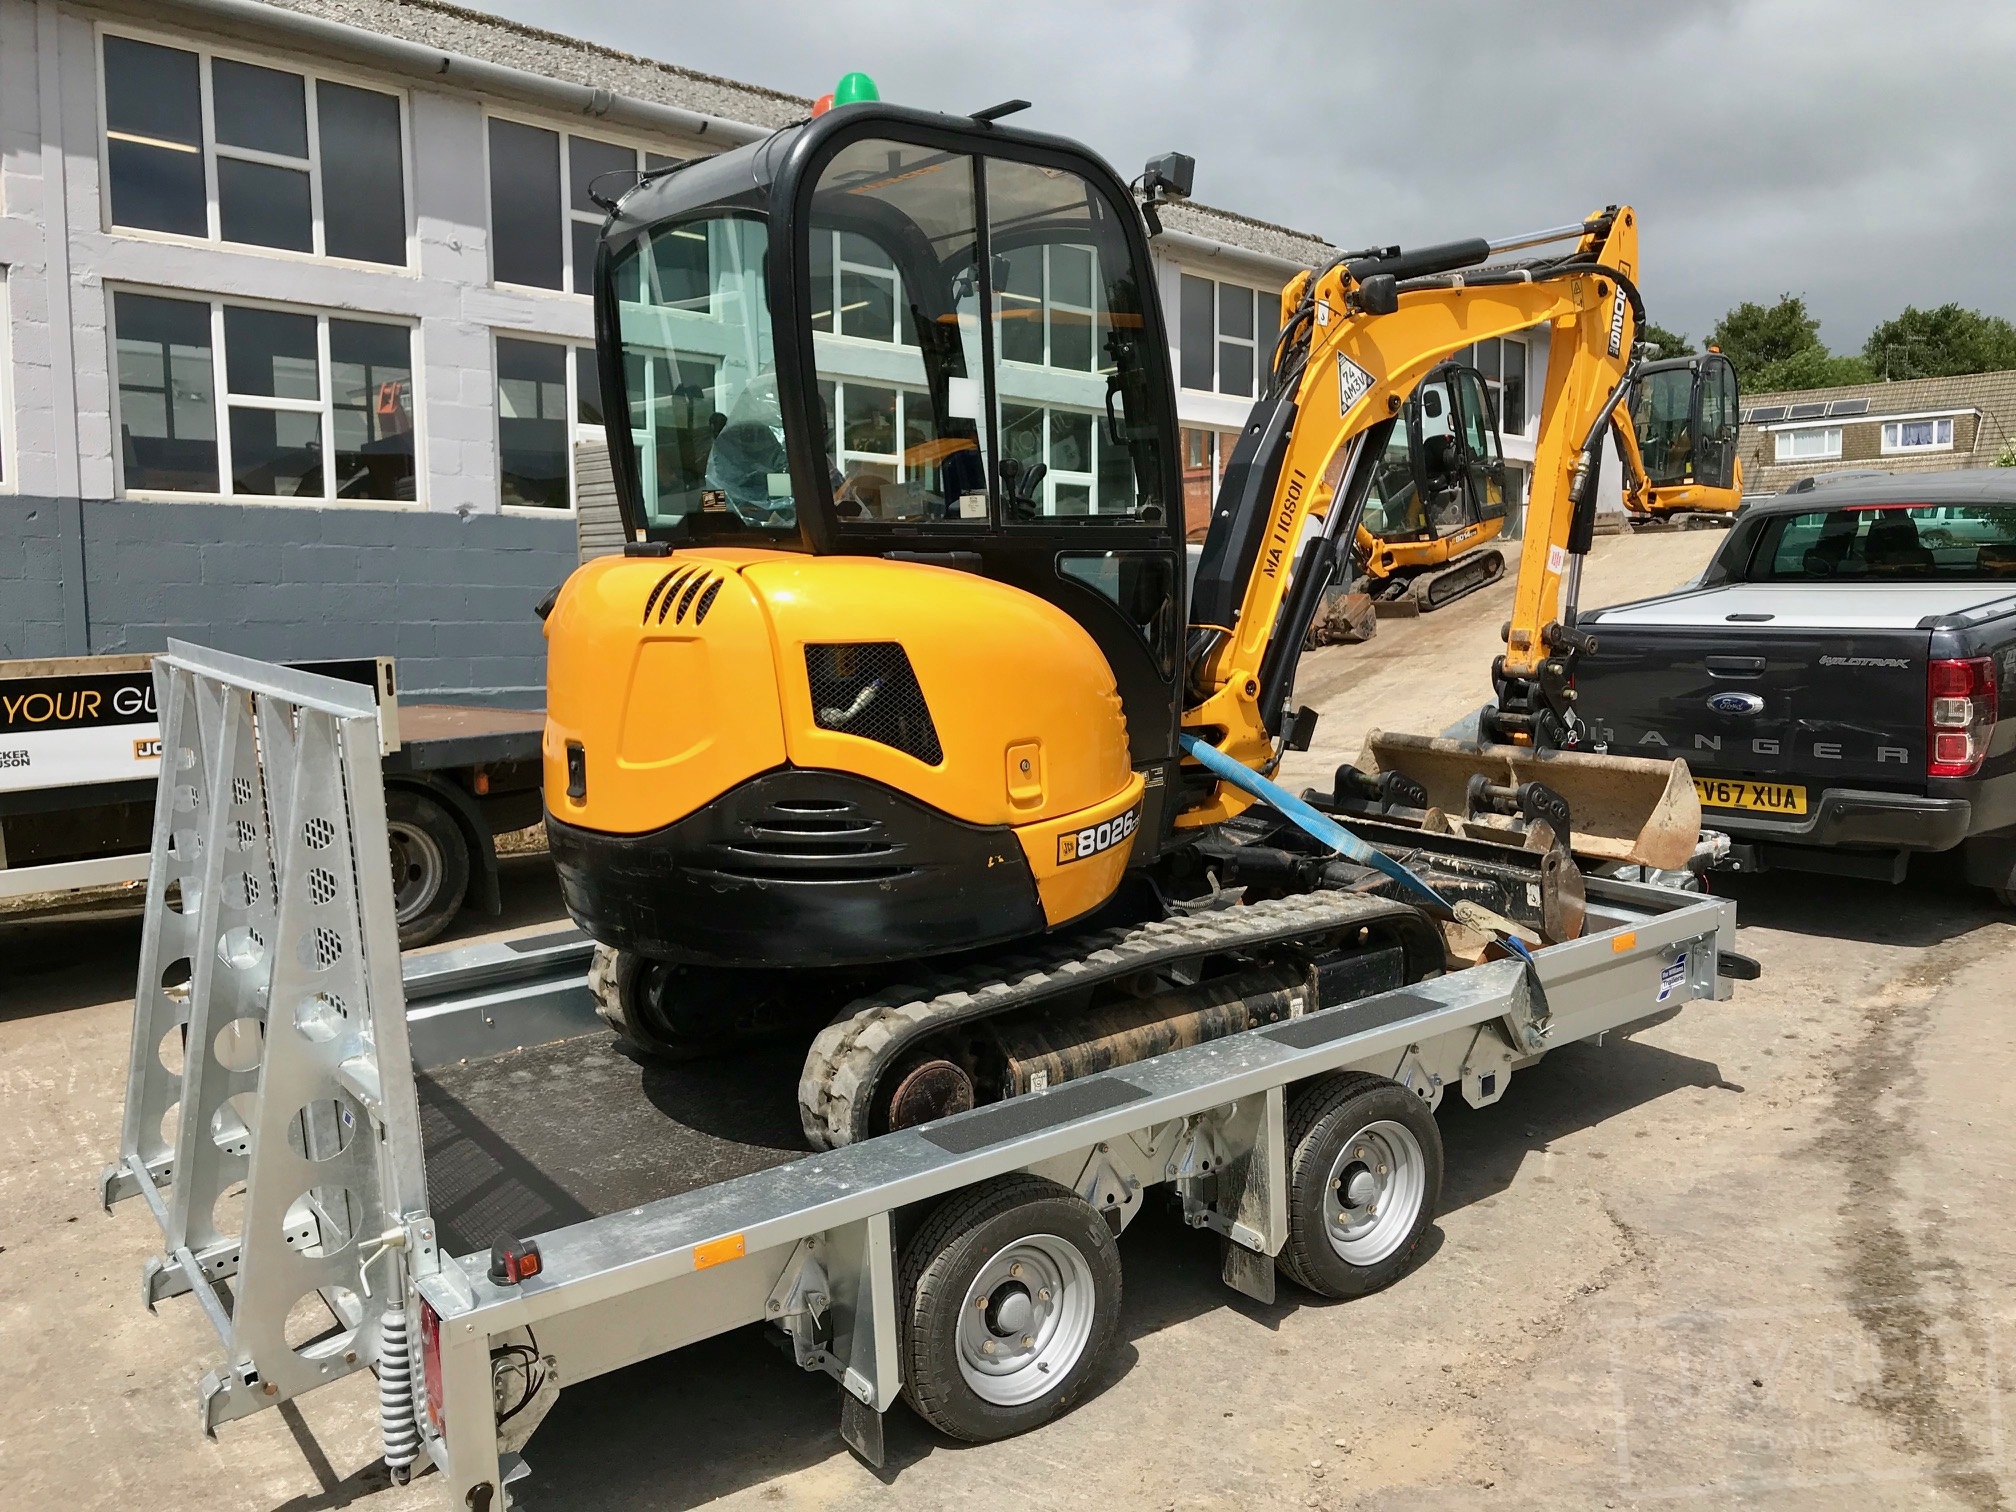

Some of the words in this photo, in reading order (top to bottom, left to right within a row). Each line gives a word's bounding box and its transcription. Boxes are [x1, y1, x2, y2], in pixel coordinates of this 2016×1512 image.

[1342, 366, 1355, 385] 74
[1819, 655, 1910, 669] WILDTRAK
[3, 690, 102, 724] YOUR
[1719, 698, 1744, 710] Ford
[1753, 785, 1797, 809] XUA
[1077, 810, 1134, 857] 8026
[1662, 974, 1684, 987] Trailers
